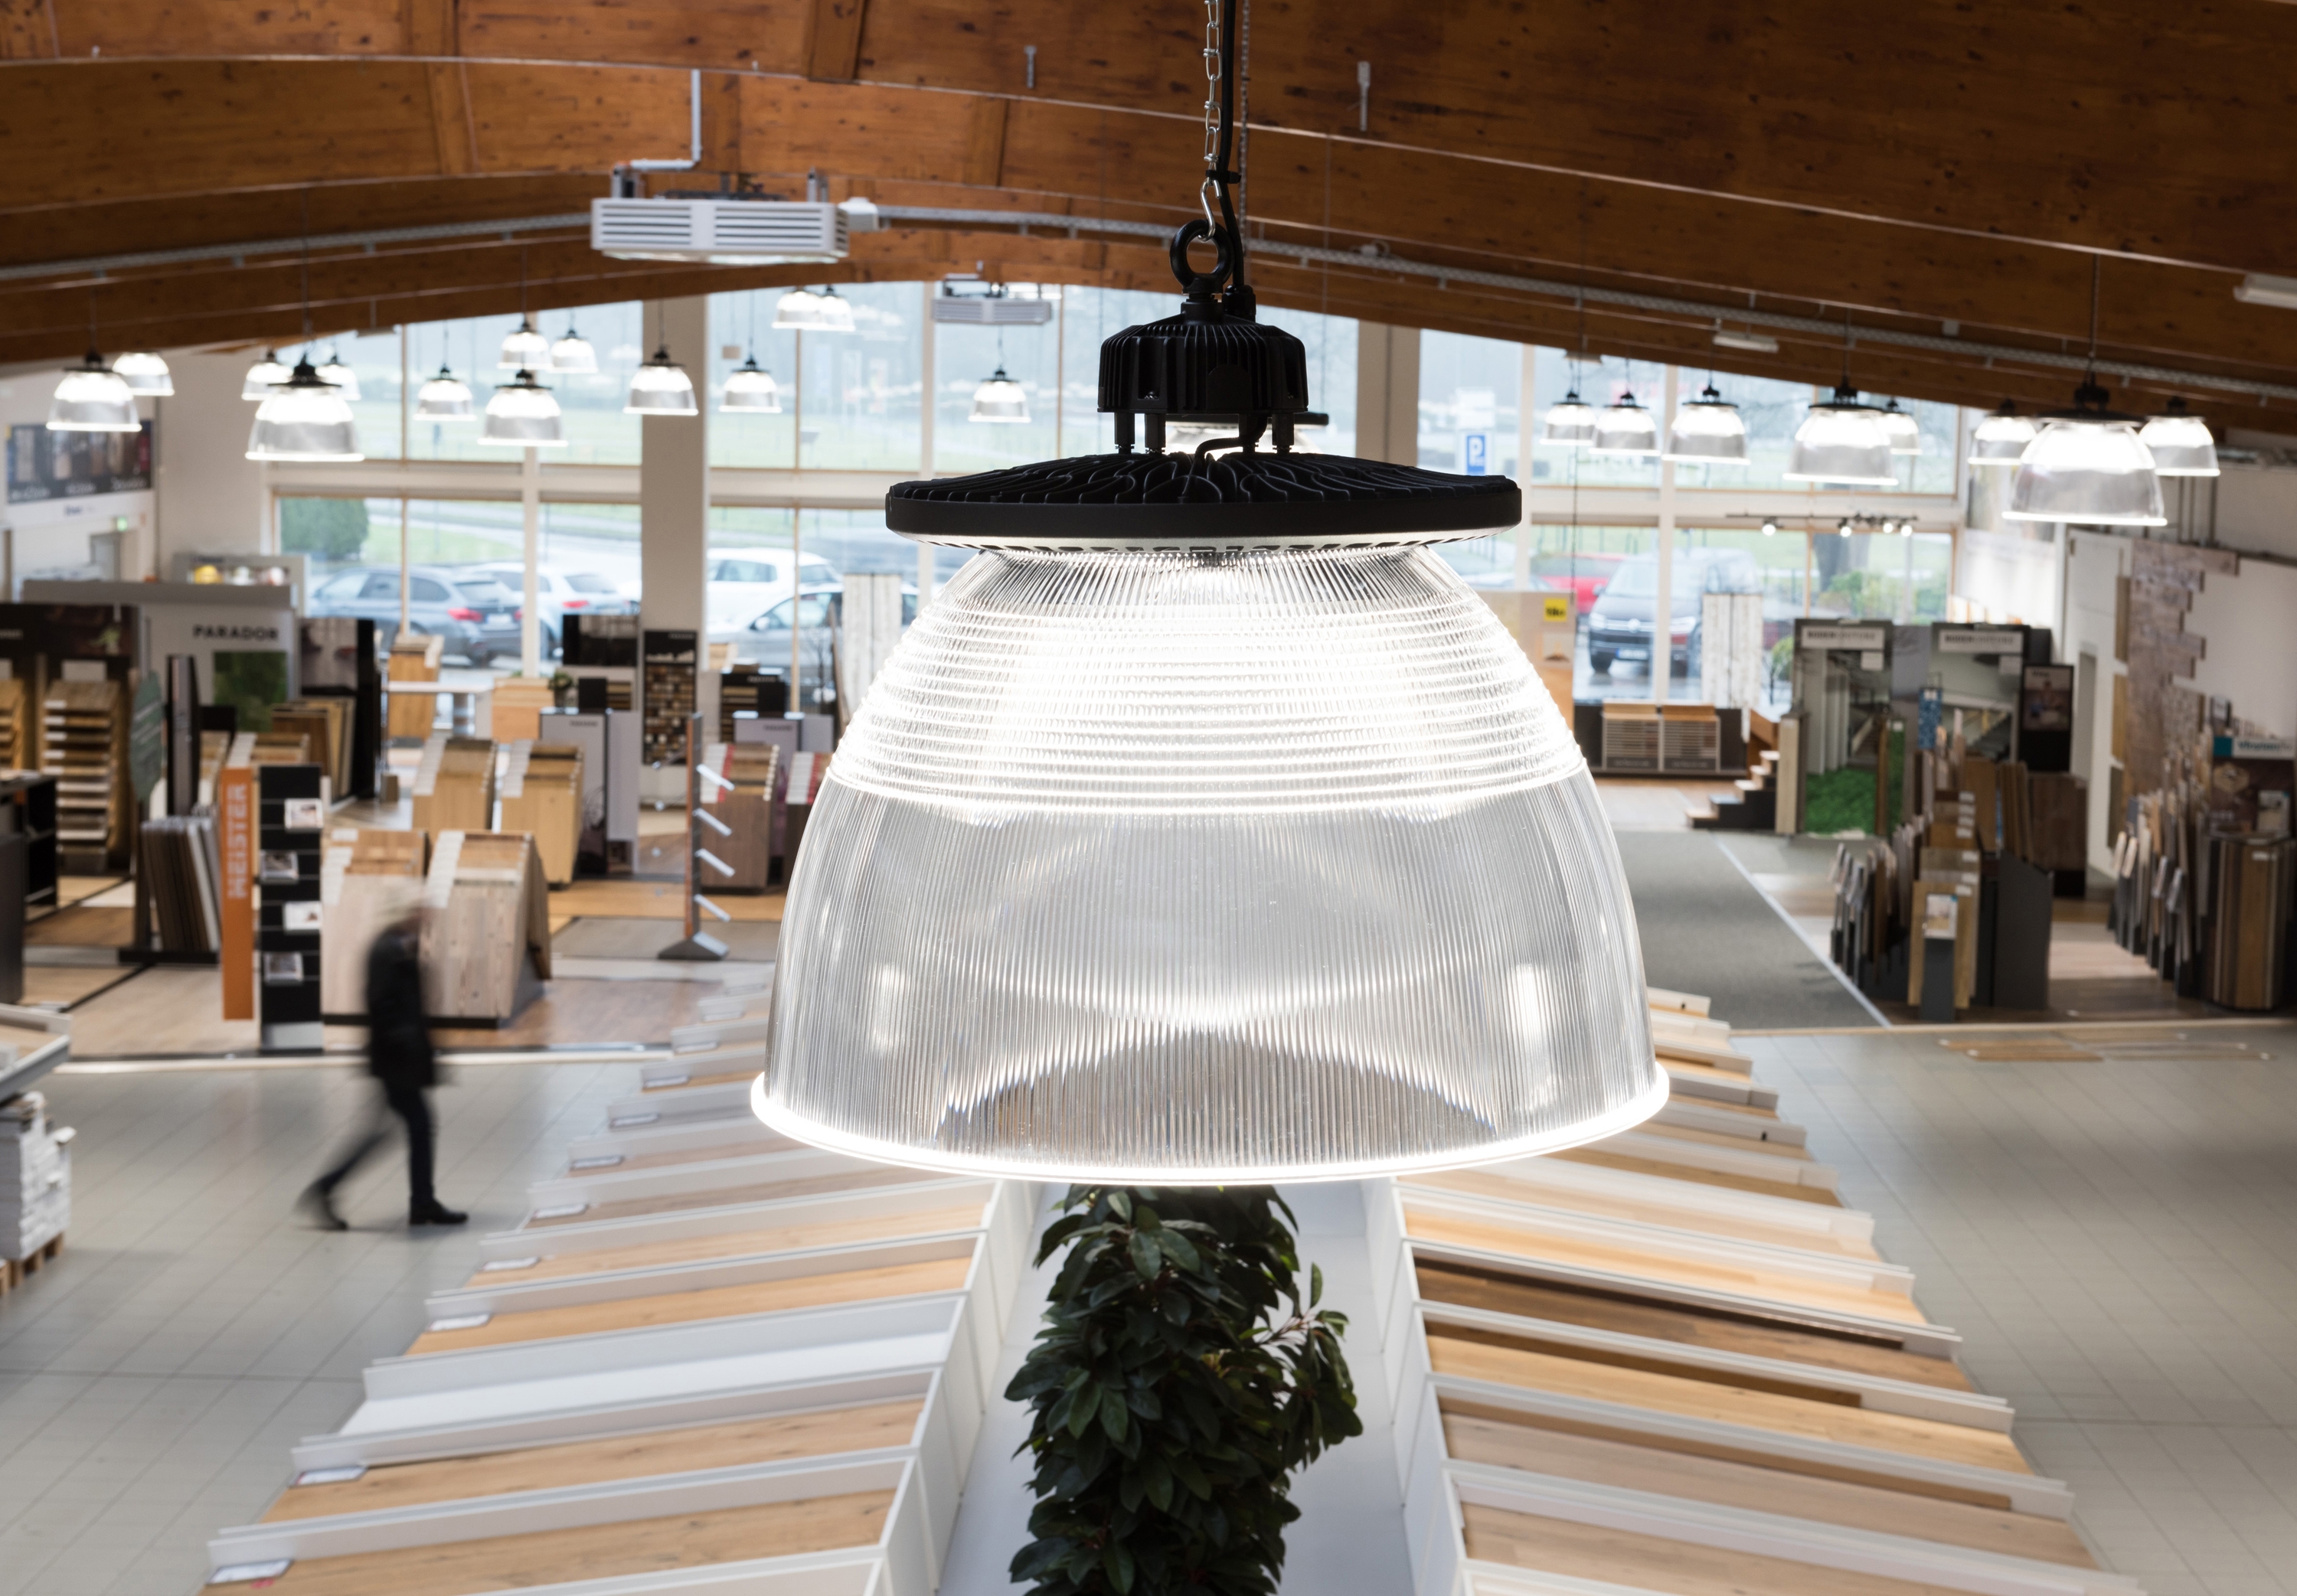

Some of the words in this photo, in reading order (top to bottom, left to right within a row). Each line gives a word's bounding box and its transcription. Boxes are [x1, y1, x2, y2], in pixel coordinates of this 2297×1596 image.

[1469, 436, 1483, 466] P
[193, 625, 278, 640] PARADOR
[227, 785, 247, 899] MEISTER
